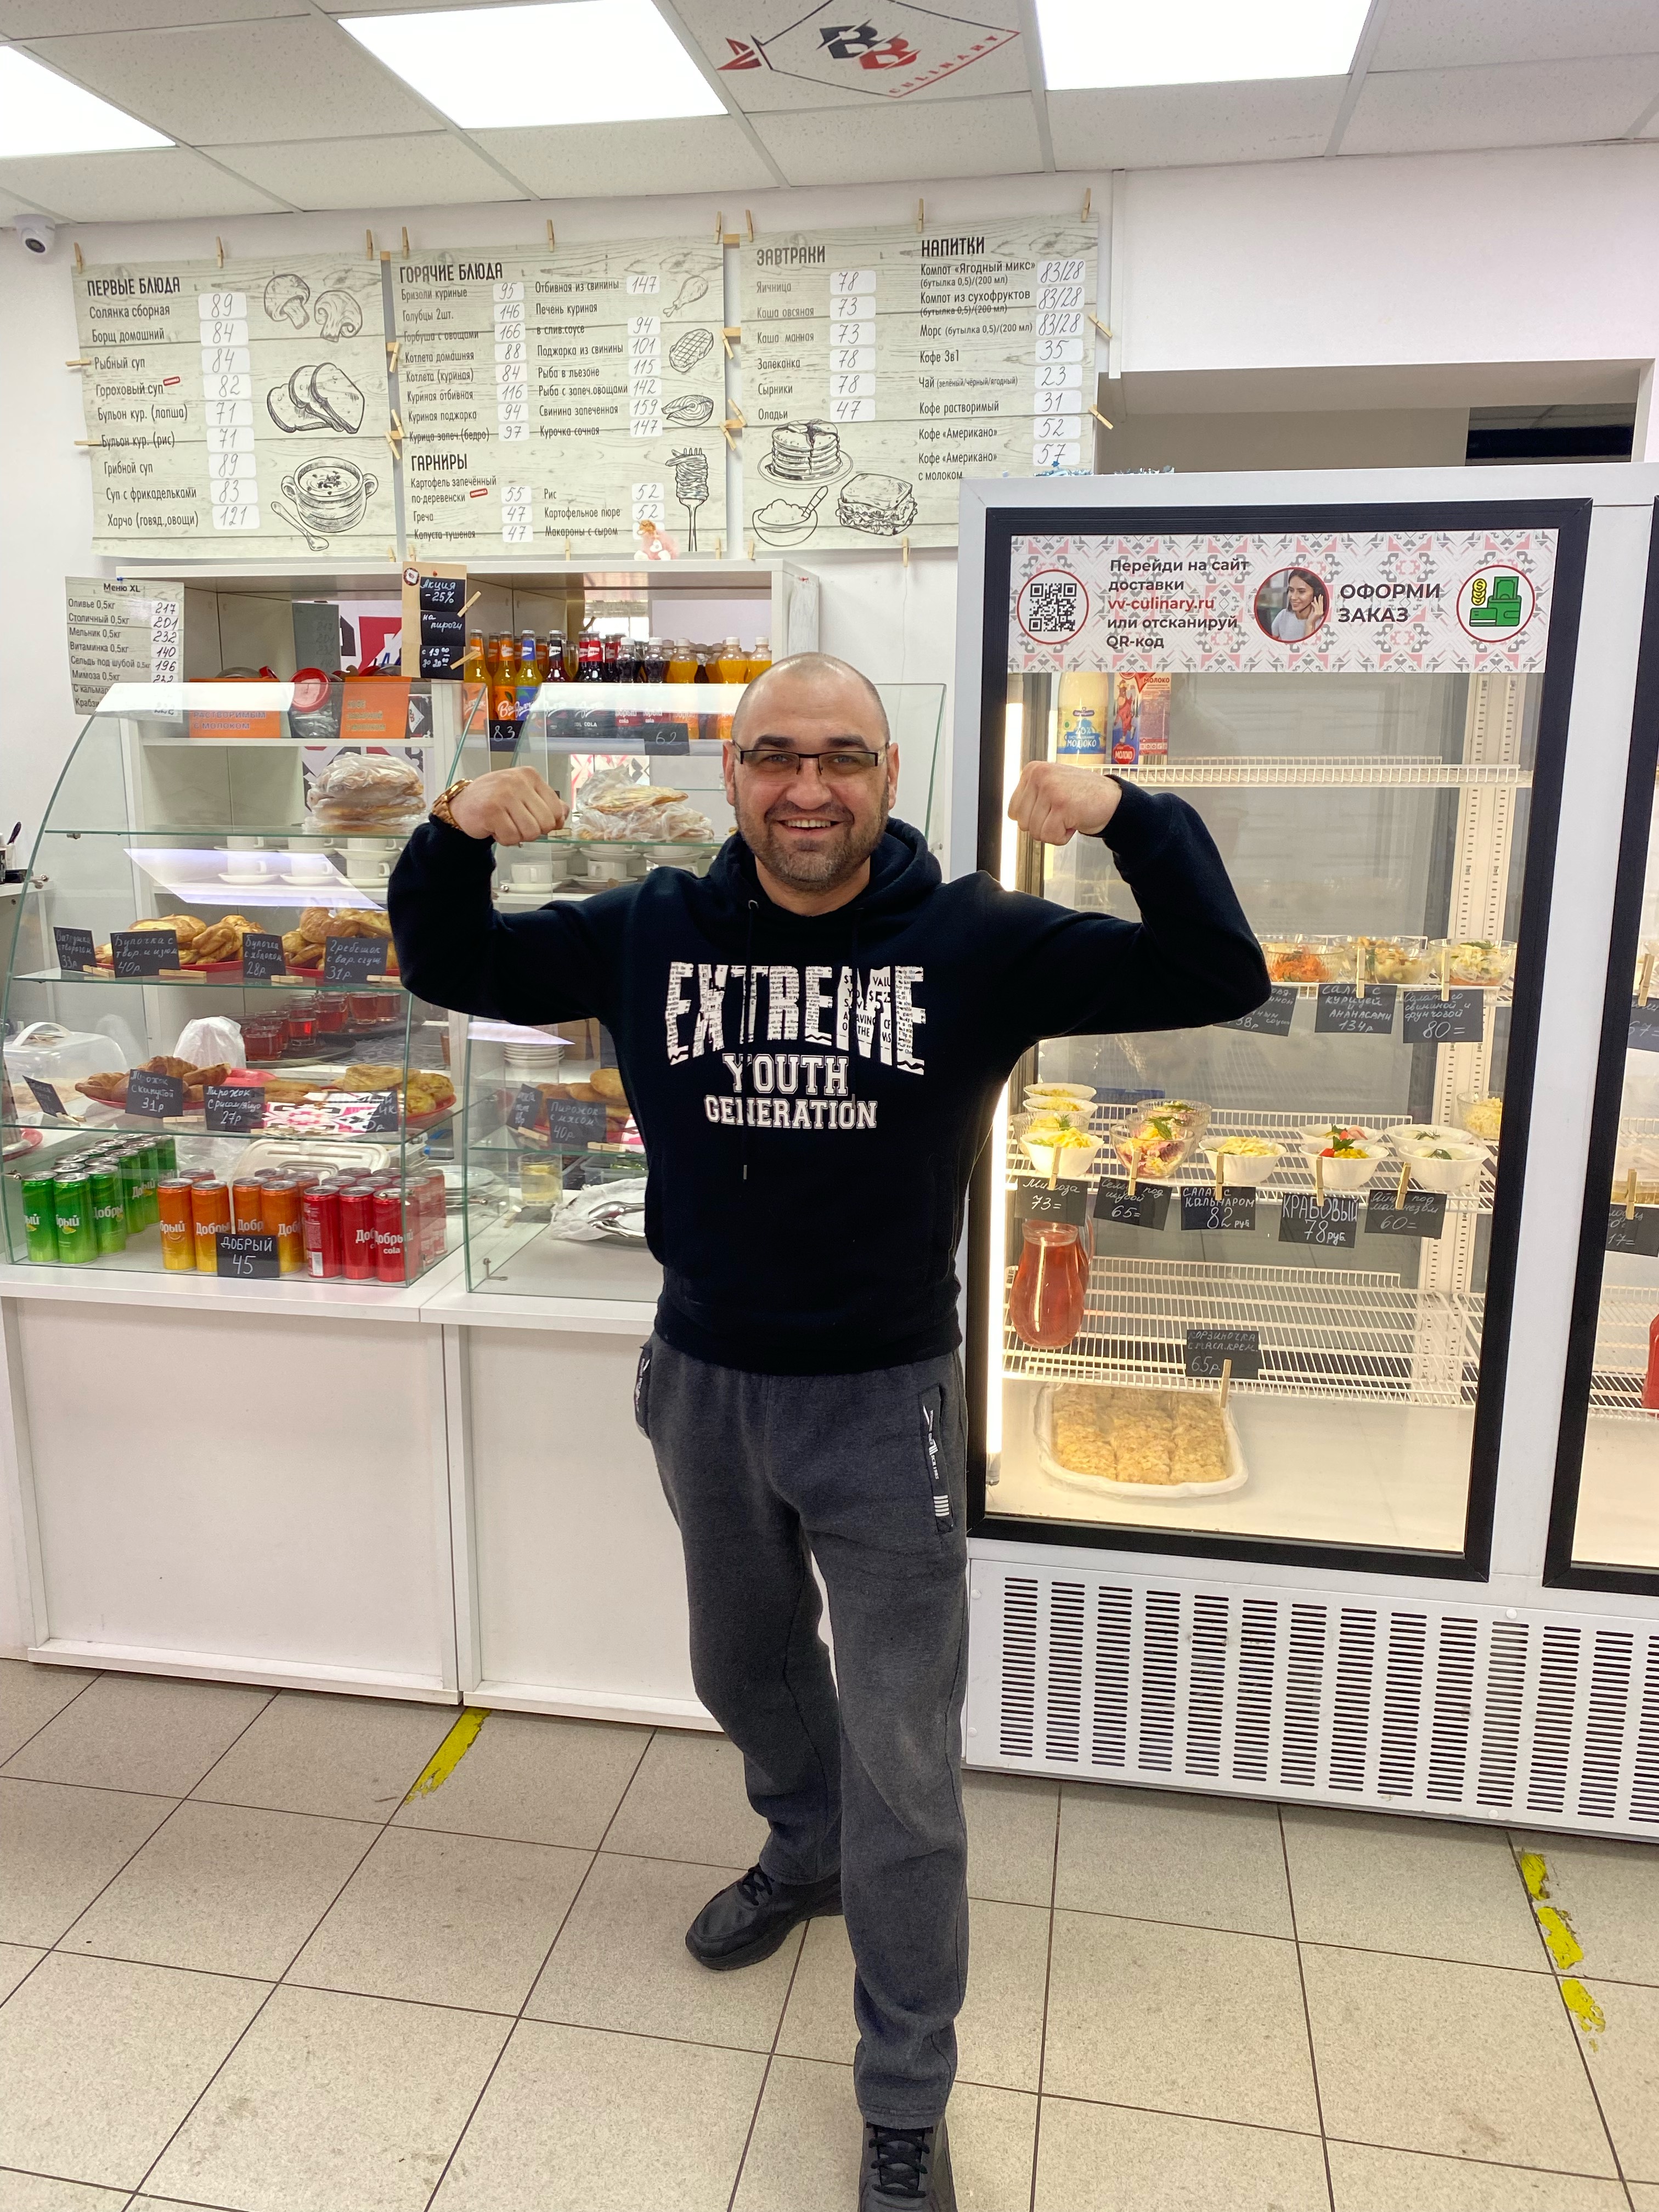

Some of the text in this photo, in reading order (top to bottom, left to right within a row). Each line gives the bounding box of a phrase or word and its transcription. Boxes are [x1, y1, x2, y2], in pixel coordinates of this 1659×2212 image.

[922, 236, 984, 257] НАПИТКИ
[757, 246, 825, 266] ЗАВТРАКИ
[400, 263, 503, 283] ГОРЯЧИЕ БЛЮДА
[921, 264, 951, 275] Компот
[955, 262, 1002, 274] «Ягодный
[87, 276, 180, 296] ПЕРВЫЕ БЛЮДА
[535, 280, 619, 293] Отбивная из свинины
[632, 276, 657, 292] 147
[757, 282, 791, 293] Яичница
[839, 272, 859, 292] 78
[402, 289, 467, 302] Бризоли куриные
[499, 283, 517, 299] 95
[921, 290, 1030, 303] Компот из сухофруктов
[89, 304, 170, 319] Солянка сборная
[211, 294, 233, 318] 89
[500, 304, 520, 320] 146
[536, 303, 597, 317] Печень куриная
[757, 307, 814, 318] Каша овсяная
[838, 297, 857, 317] 73
[403, 308, 454, 324] Голубцы 2шт.
[92, 328, 165, 345] Борщ домашний
[213, 321, 234, 344] 84
[757, 332, 814, 343] Каша манная
[839, 324, 859, 344] 73
[1040, 340, 1069, 360] 35
[94, 356, 145, 370] Рыбный суп
[212, 348, 235, 373] 84
[757, 358, 800, 370] Запеканка
[839, 350, 859, 368] 78
[921, 351, 941, 366] Кофе
[95, 383, 164, 398] Гороховый суп
[218, 375, 241, 396] 82
[502, 385, 523, 399] 116
[758, 383, 793, 397] Сырники
[838, 375, 860, 394] 78
[407, 390, 473, 404] Куриная отбивная
[1042, 392, 1063, 411] 31
[98, 404, 188, 421] Бульон кур. (лапша)
[216, 402, 236, 423] 71
[504, 404, 521, 420] 94
[540, 405, 618, 416] Свинина запеченная
[634, 400, 658, 415] 159
[758, 409, 788, 420] Оладьи
[837, 400, 861, 420] 47
[920, 401, 999, 416] Кофе растворимый
[408, 411, 476, 424] Куриная поджарка
[919, 428, 997, 441] Кофе «Американо»
[1039, 419, 1064, 437] 52
[104, 462, 153, 475] Грибной суп
[218, 454, 238, 477] 89
[411, 454, 467, 471] ГАРНИРЫ
[411, 476, 496, 489] Картофель запечённый
[411, 493, 465, 505] по-деревенски
[505, 487, 525, 501] 55
[544, 489, 557, 499] Рис
[636, 484, 659, 499] 52
[220, 507, 247, 527] 121
[414, 511, 433, 523] Греча
[507, 506, 526, 521] 47
[545, 507, 620, 520] Картофельное пюре
[636, 505, 658, 518] 52
[108, 513, 133, 528] Харчо
[1110, 558, 1249, 574] Перейди на сайт
[104, 583, 127, 591] Меню
[420, 579, 456, 590] Акция
[1109, 581, 1184, 592] доставки
[1340, 584, 1440, 599] ОФОРМИ
[69, 599, 94, 608] Оливье
[156, 602, 176, 614] 217
[1109, 597, 1214, 612] vv-culinary.ru
[69, 613, 108, 623] Столичный
[1339, 608, 1408, 622] ЗАКАЗ
[154, 617, 178, 630] 201
[1108, 616, 1237, 630] или отсканируй
[70, 628, 100, 637] Мельник
[153, 631, 177, 643] 232
[70, 642, 108, 652] Витаминка
[1107, 635, 1164, 649] QR-код
[157, 647, 176, 657] 140
[494, 725, 515, 742] 83
[656, 731, 678, 744] 62
[665, 962, 926, 1075] EXTREME
[722, 1053, 849, 1096] YOUTH
[704, 1094, 878, 1129] GENERATION
[221, 1237, 273, 1252] ДОБРЫЙ
[233, 1254, 256, 1274] 45
